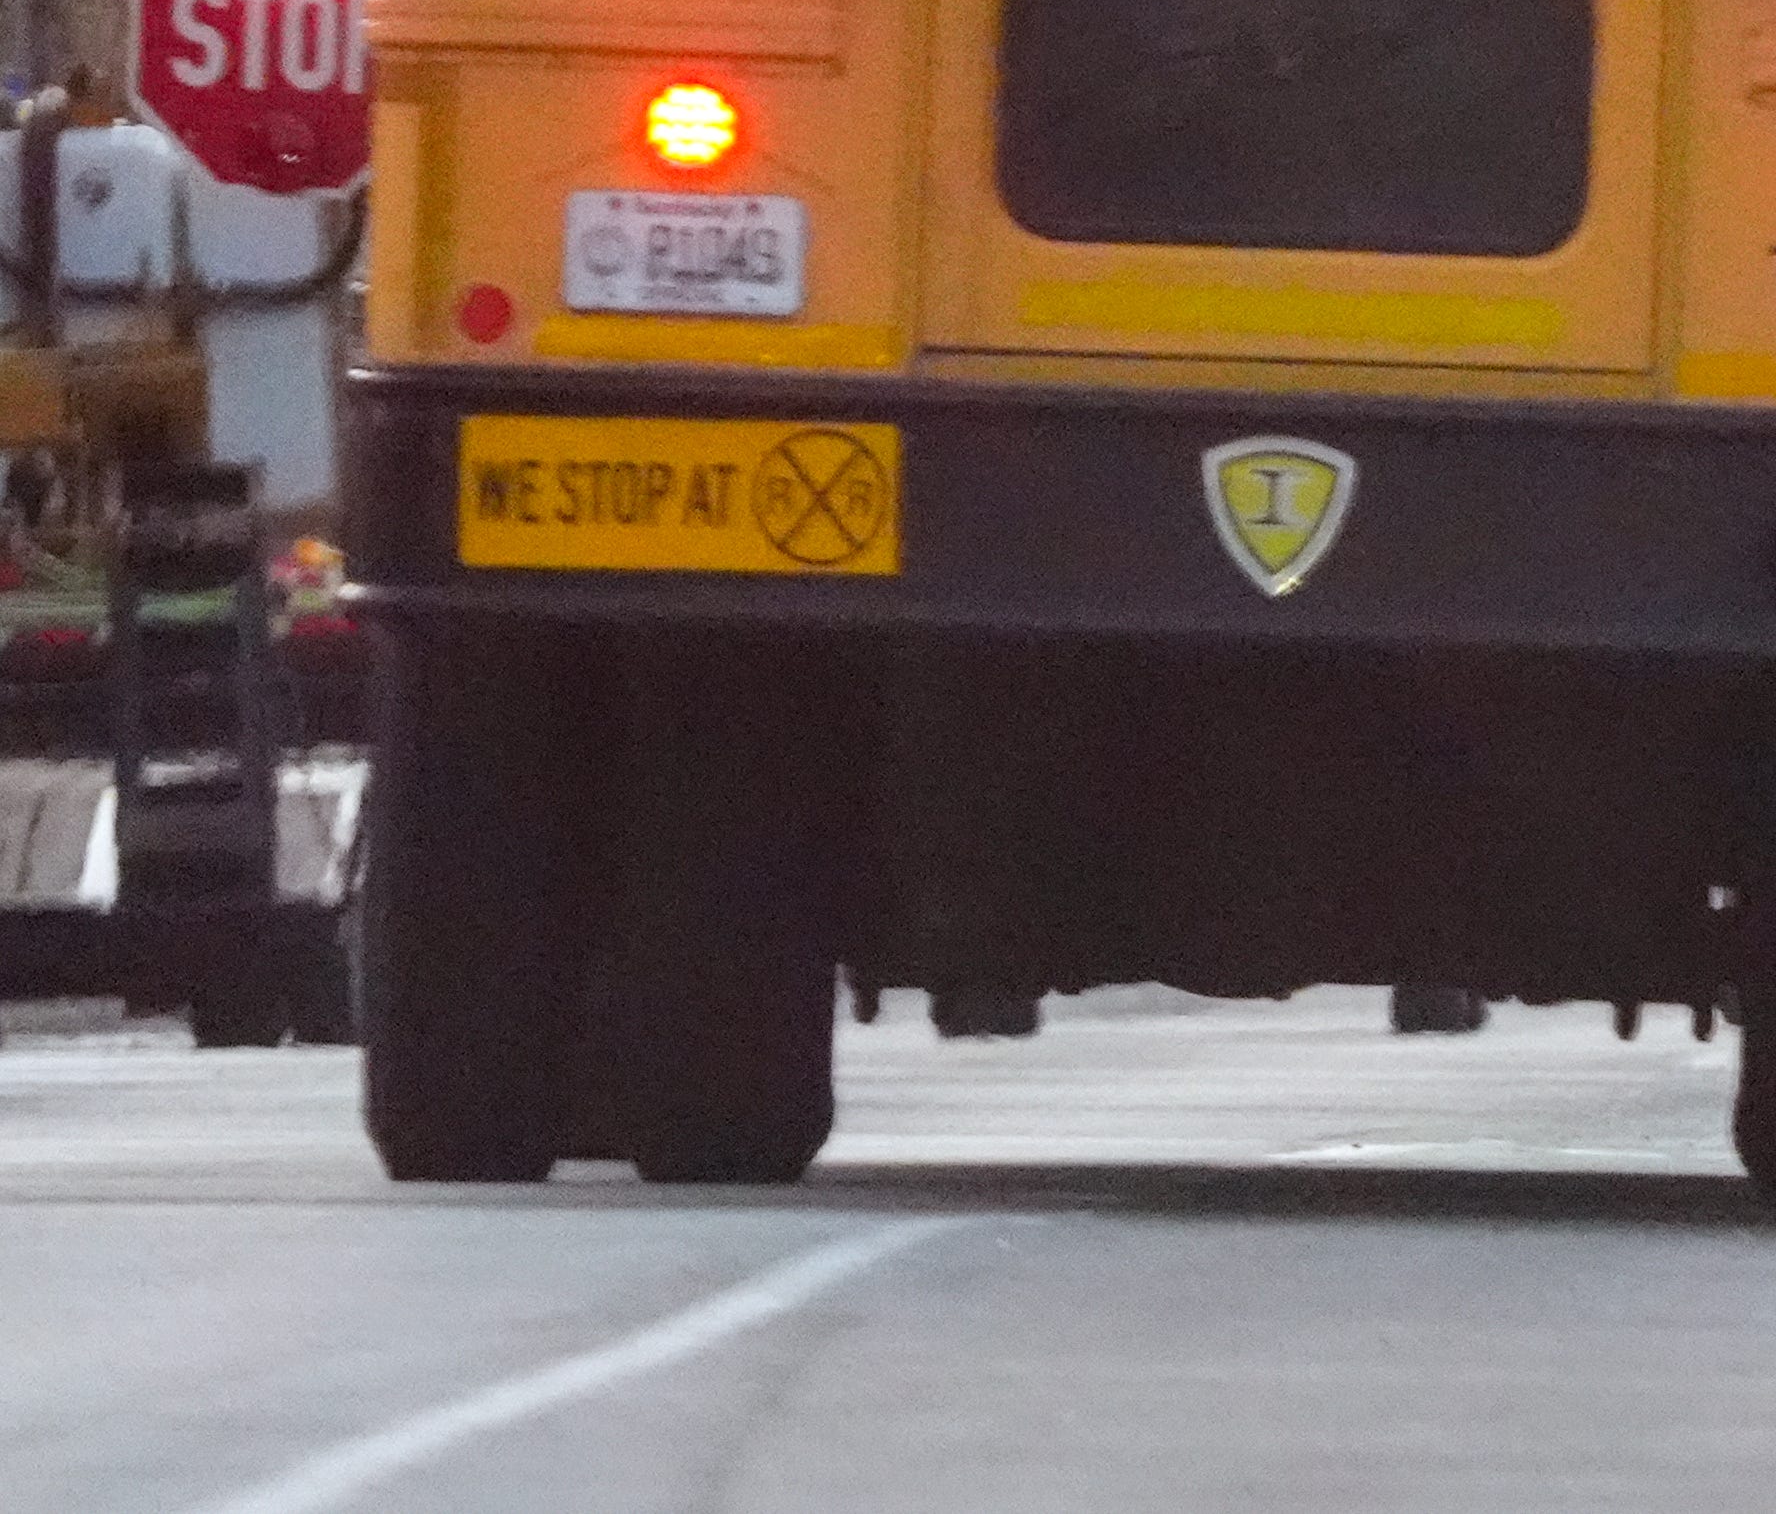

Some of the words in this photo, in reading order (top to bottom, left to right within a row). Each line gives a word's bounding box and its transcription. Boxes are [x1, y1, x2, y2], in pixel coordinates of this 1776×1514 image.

[474, 459, 542, 524] WE
[554, 460, 674, 526] STOP
[681, 463, 740, 528] AT
